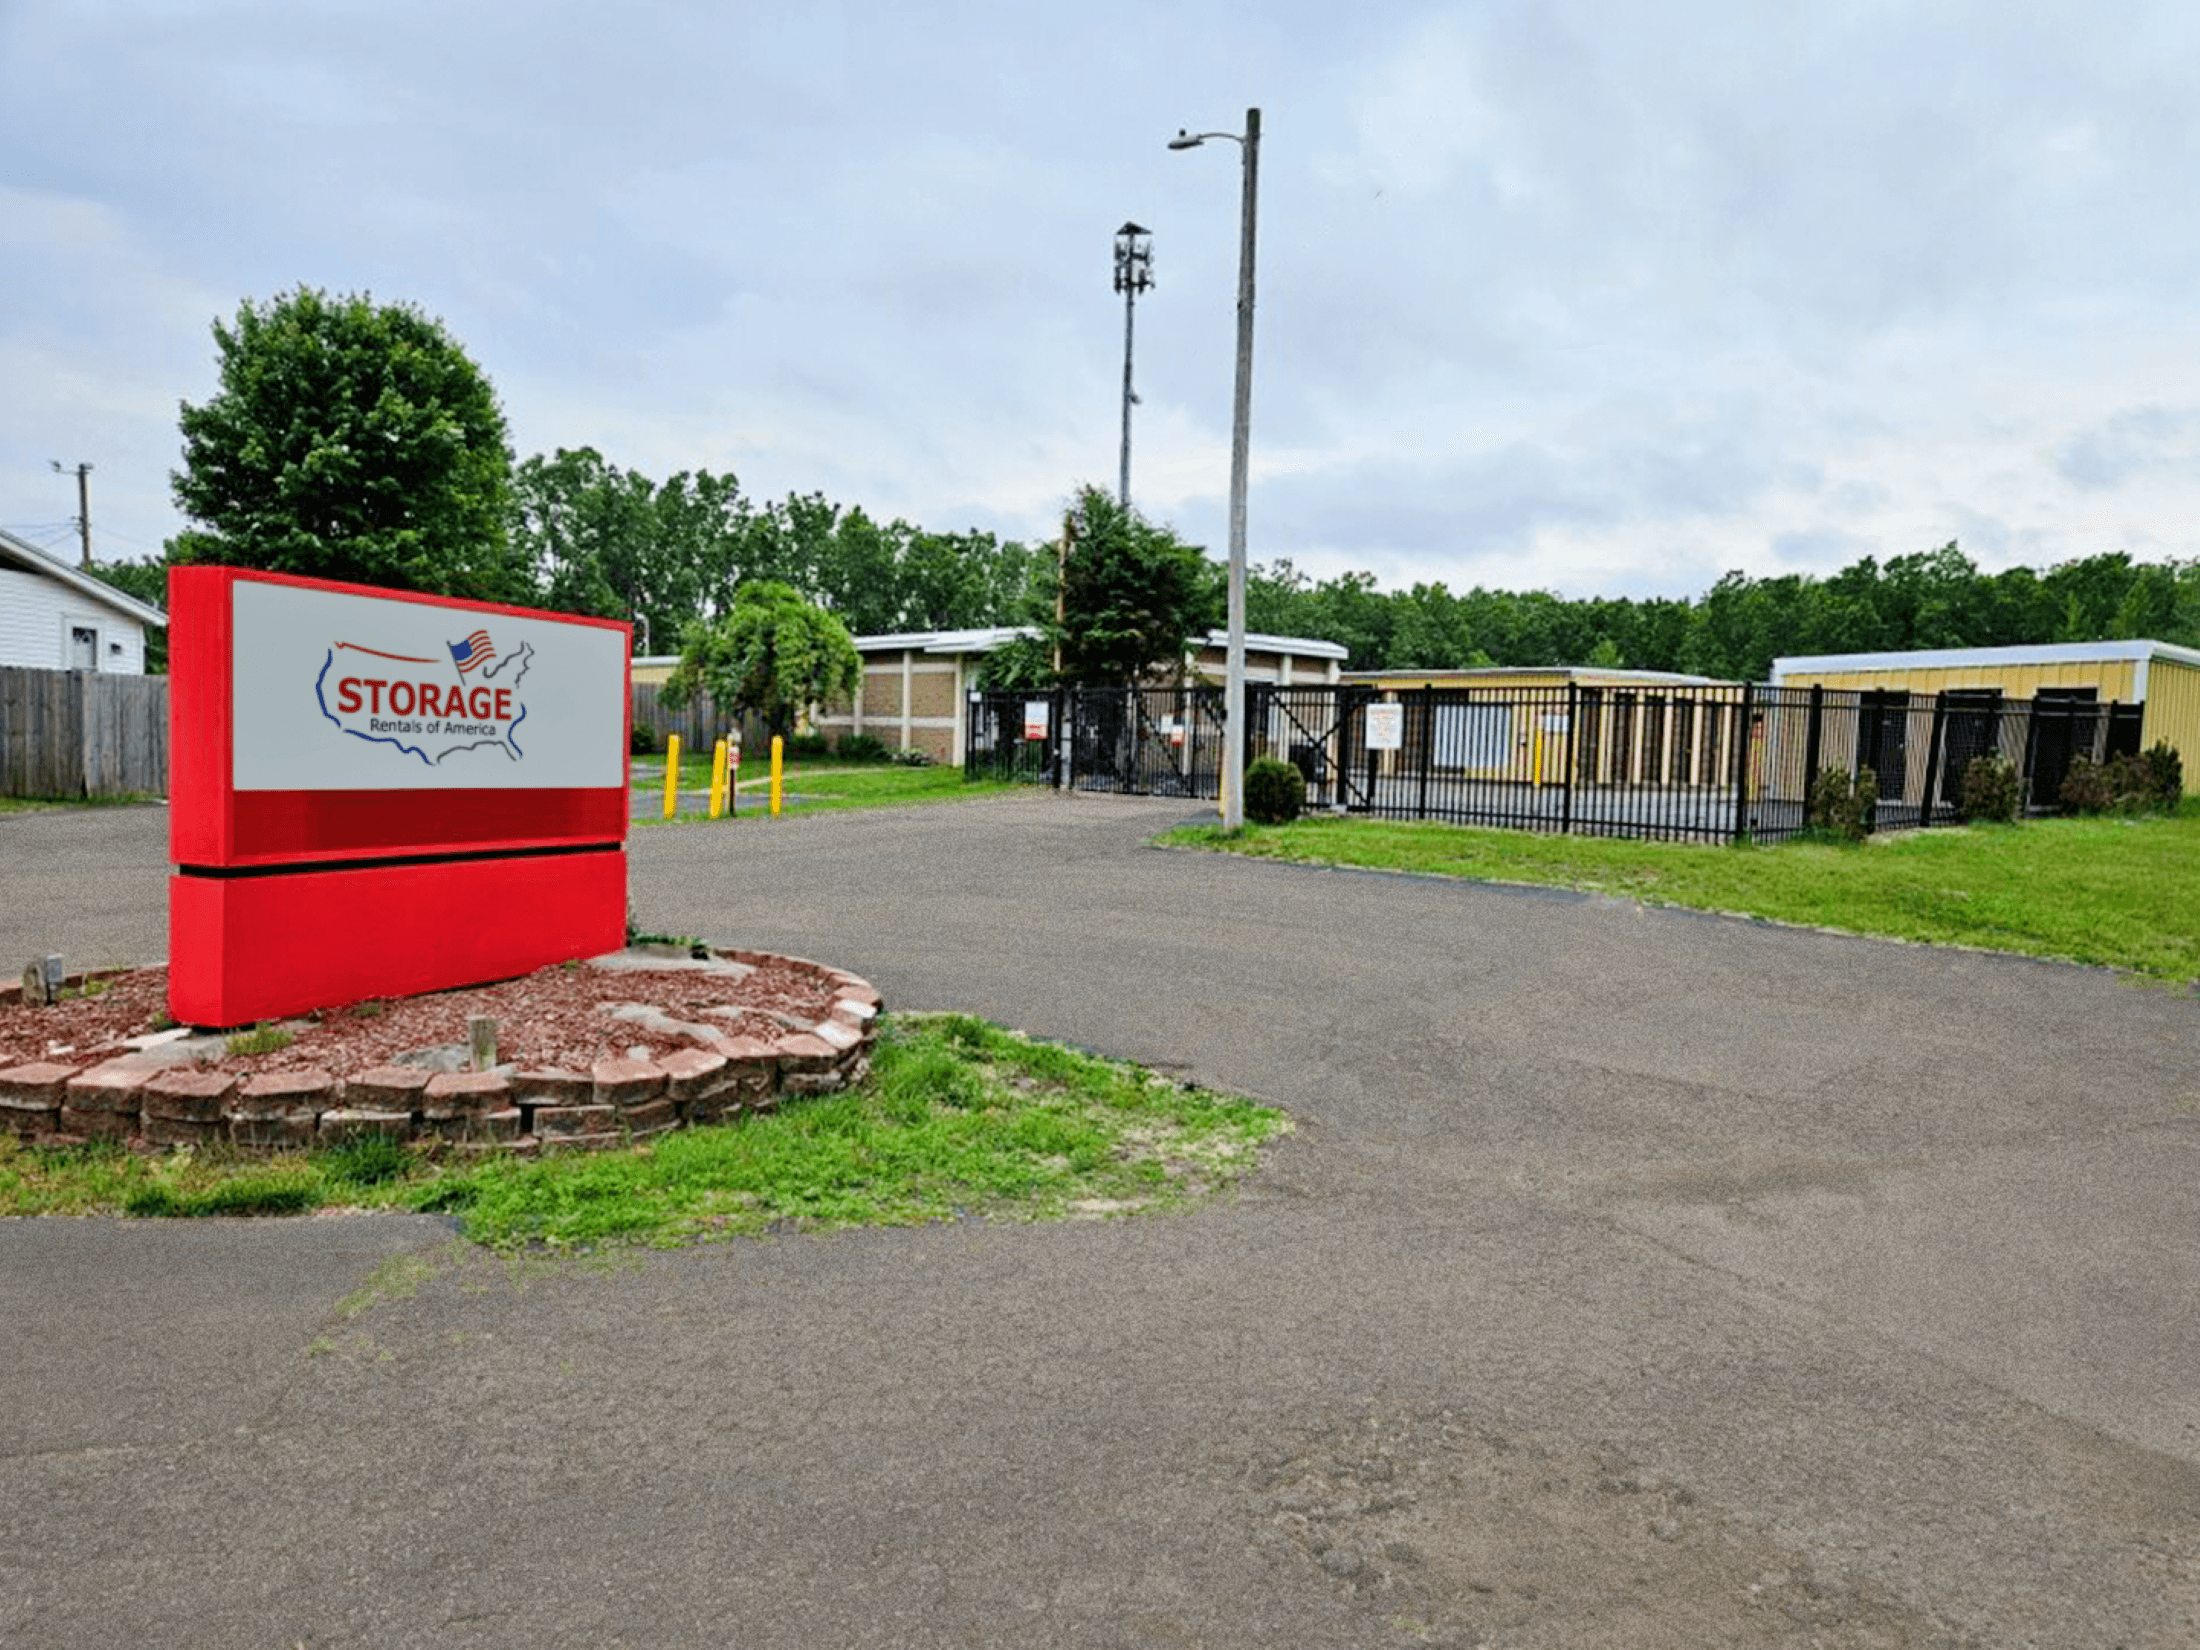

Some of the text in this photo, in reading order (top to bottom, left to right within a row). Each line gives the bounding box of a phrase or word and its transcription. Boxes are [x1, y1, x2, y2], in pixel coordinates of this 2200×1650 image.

[337, 676, 512, 721] STORAGE
[370, 718, 496, 736] Rentals of America
